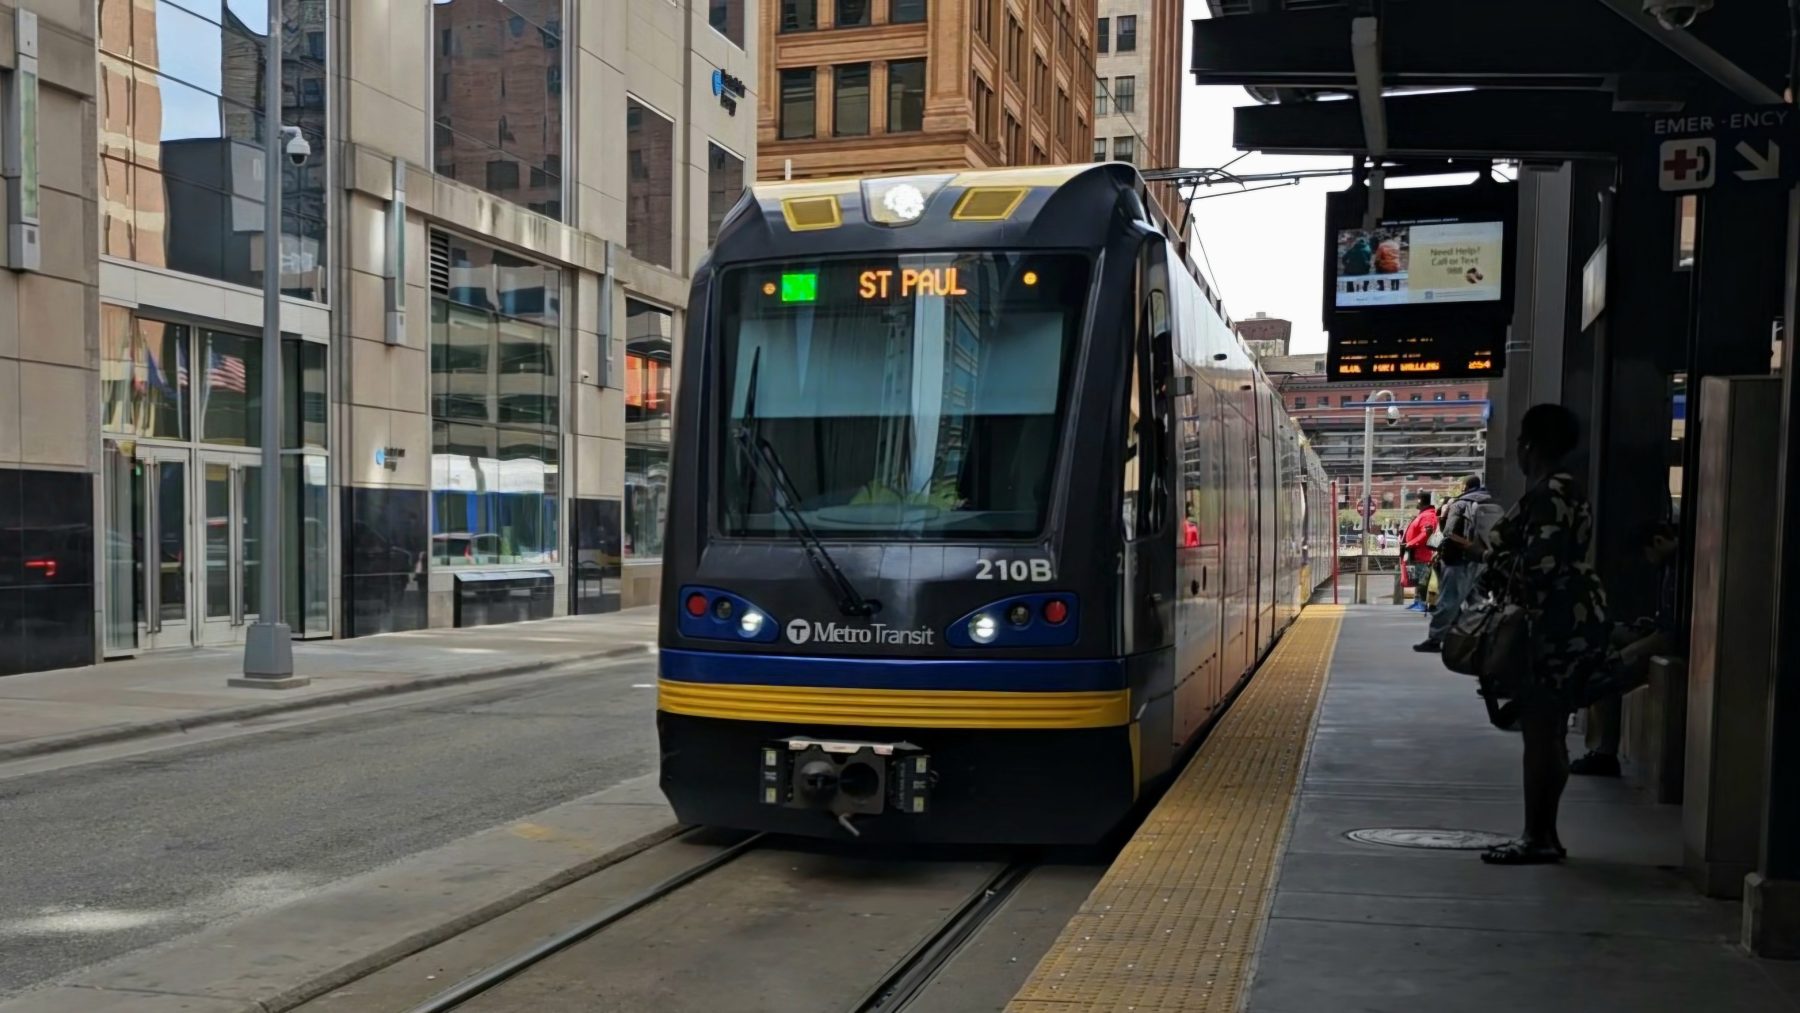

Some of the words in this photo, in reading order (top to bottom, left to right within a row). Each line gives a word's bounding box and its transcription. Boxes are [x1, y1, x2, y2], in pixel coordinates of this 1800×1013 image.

[1654, 111, 1788, 134] EMERENCY
[860, 270, 892, 298] ST
[902, 267, 967, 296] PAUL
[975, 558, 1053, 583] 210B
